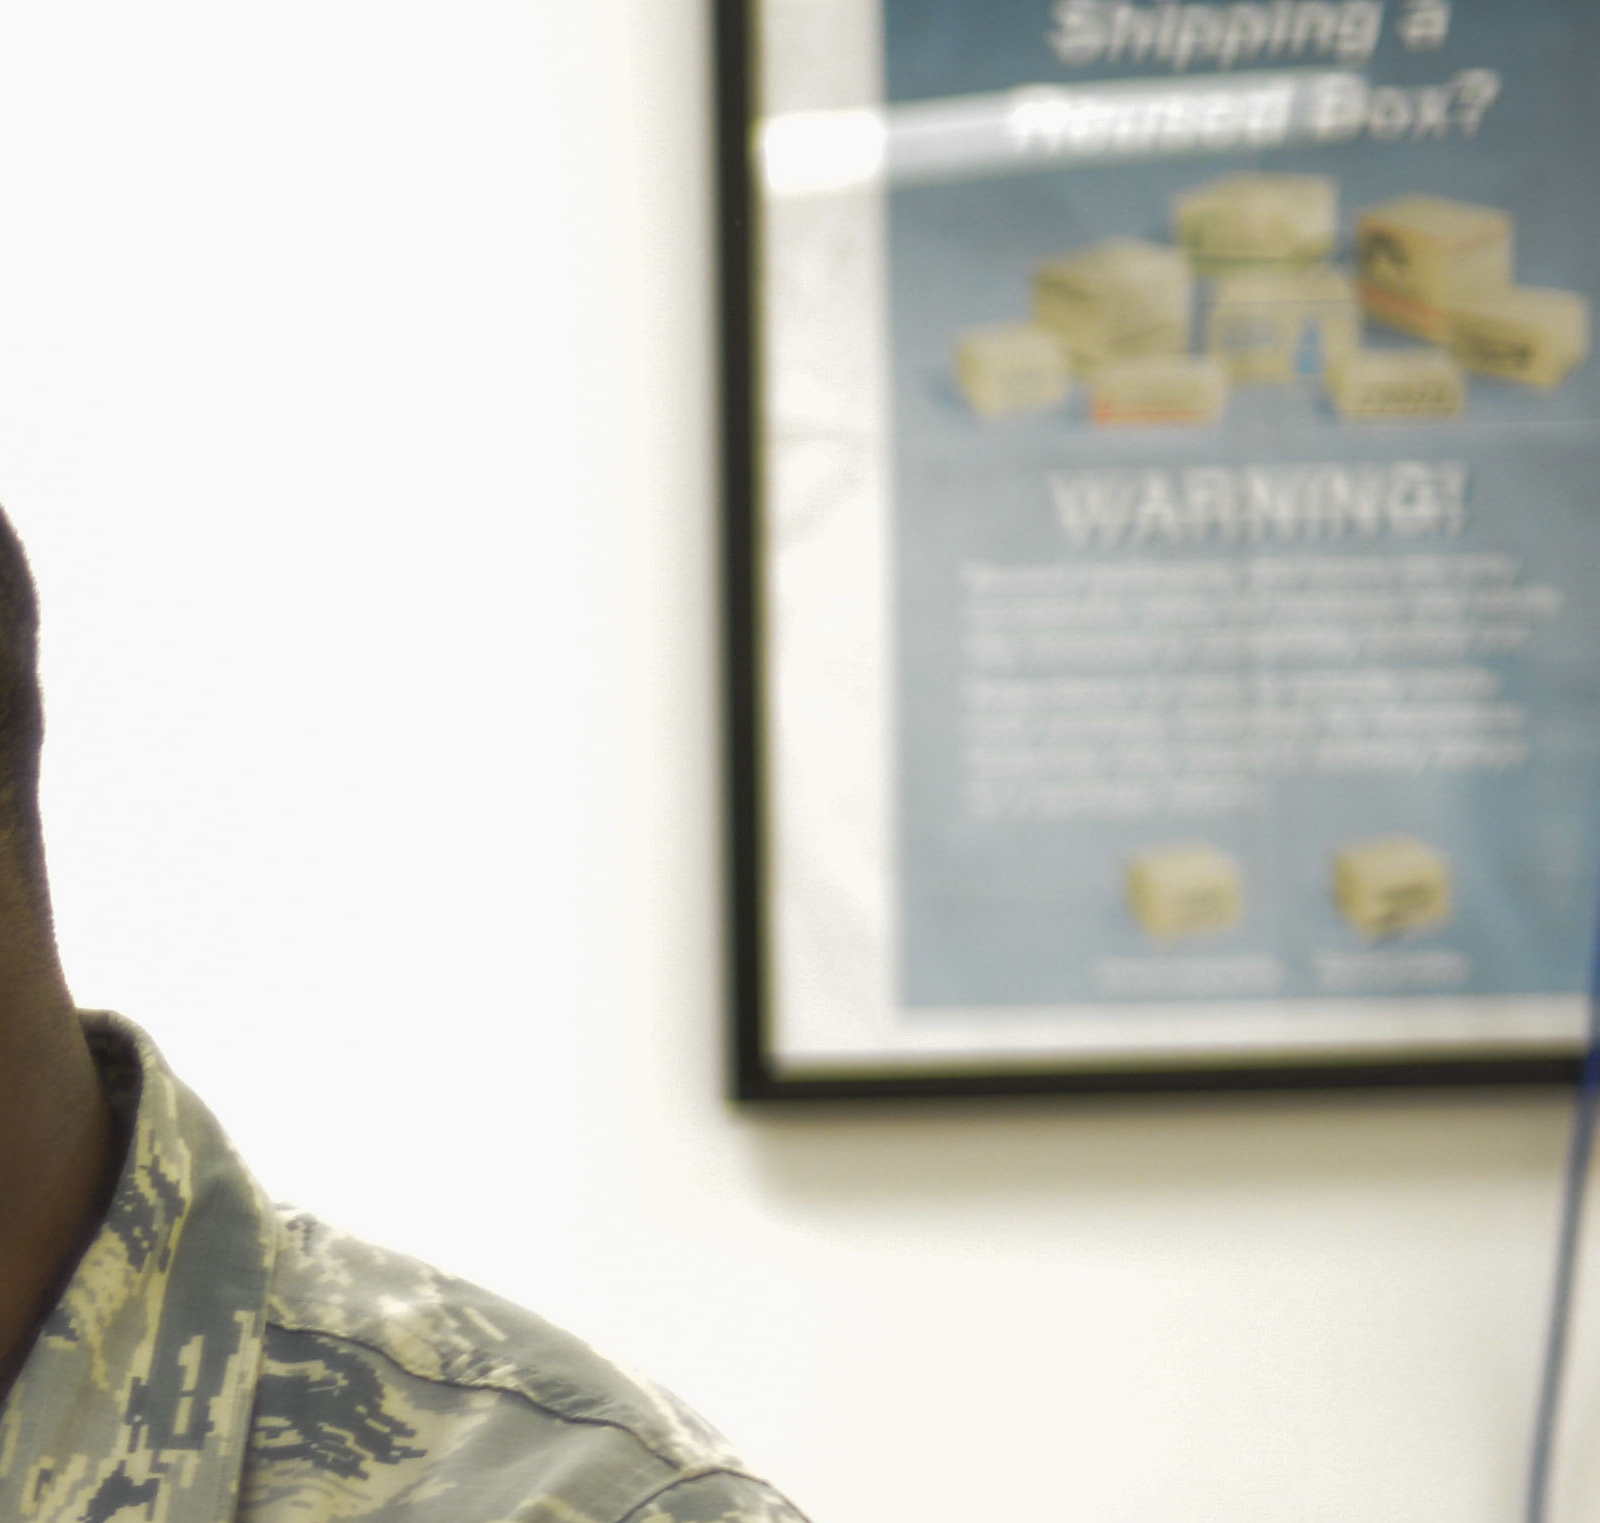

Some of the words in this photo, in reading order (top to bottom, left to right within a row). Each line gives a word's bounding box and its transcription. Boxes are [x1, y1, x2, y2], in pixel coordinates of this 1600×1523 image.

[1048, 0, 1383, 69] Shipping
[1397, 0, 1451, 50] a
[1313, 68, 1501, 142] Box?
[1049, 462, 1467, 544] WARNING!
